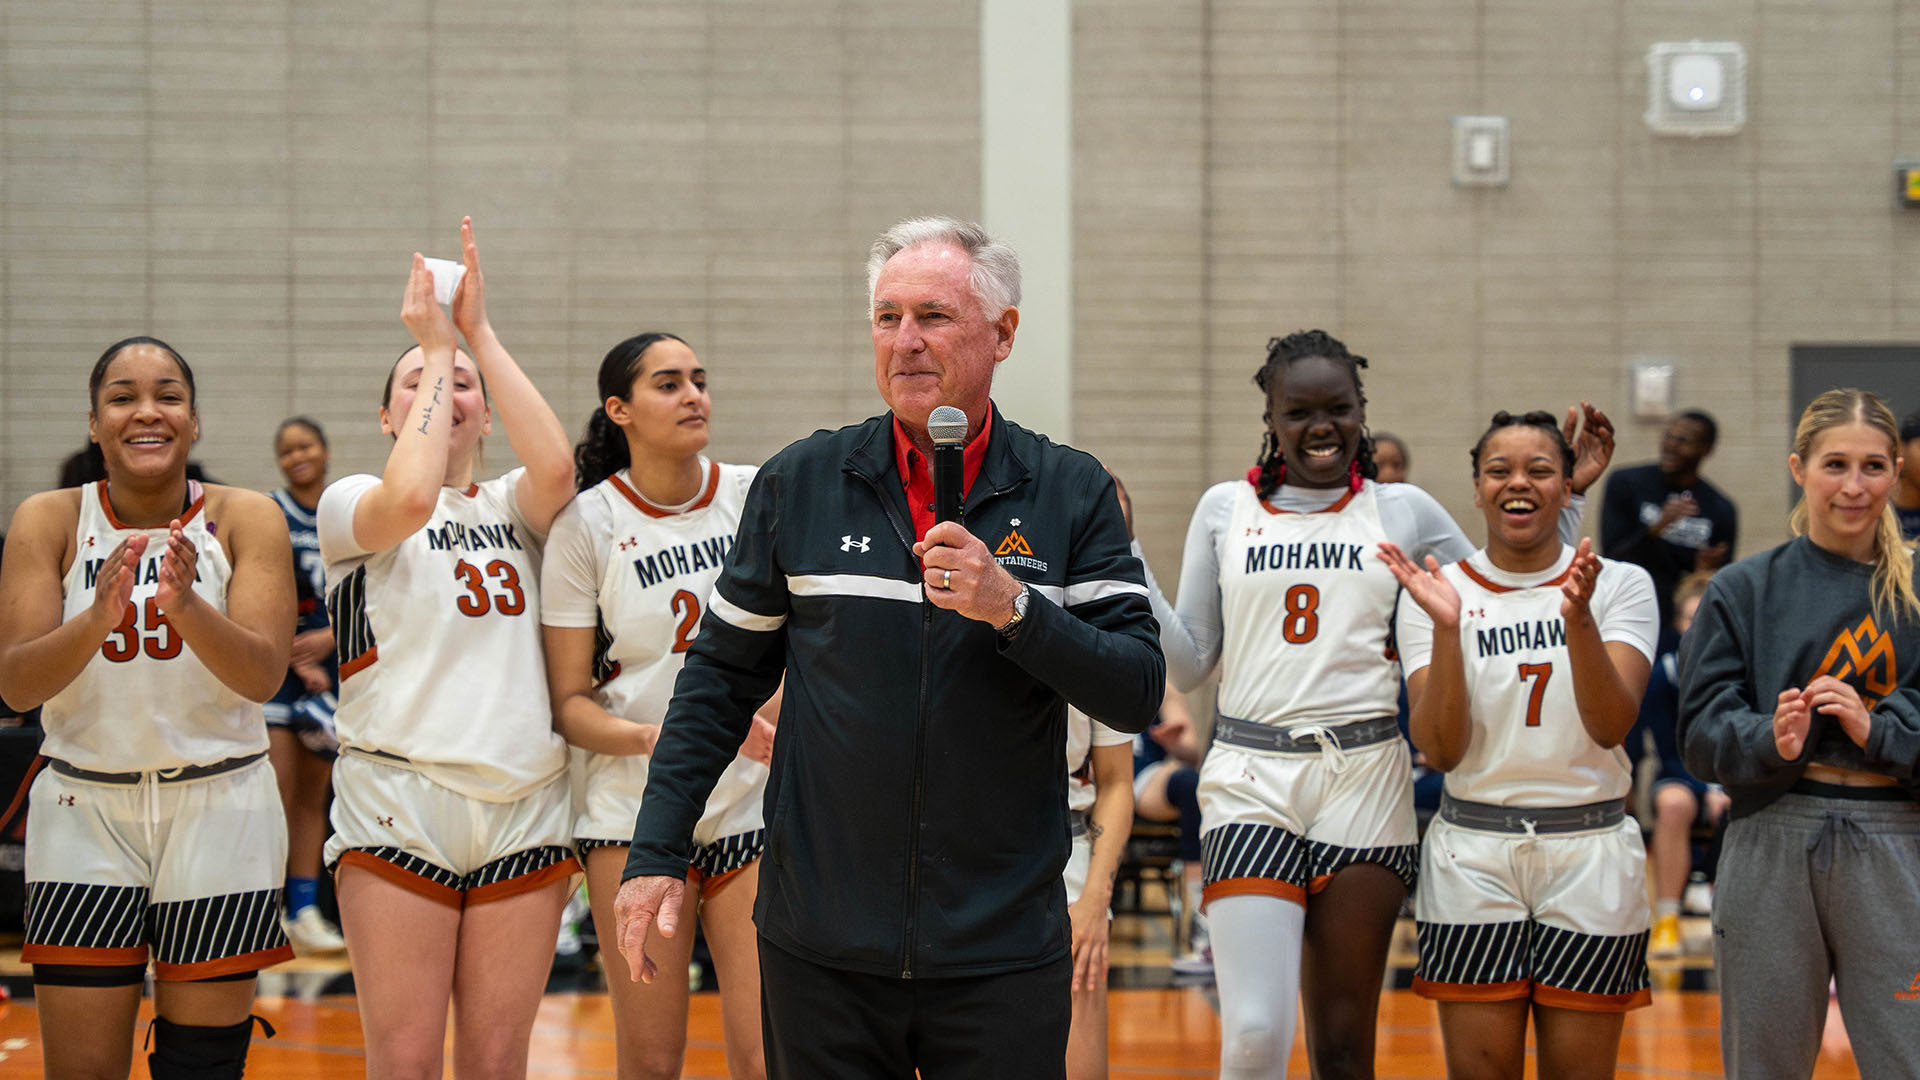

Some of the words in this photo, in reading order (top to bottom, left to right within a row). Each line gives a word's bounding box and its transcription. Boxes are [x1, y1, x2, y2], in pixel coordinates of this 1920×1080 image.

[427, 520, 522, 552] MOHAWK
[633, 535, 737, 589] MOHAW
[1245, 542, 1364, 574] MOHAWK
[454, 558, 526, 617] 33
[994, 556, 1048, 572] NTAINEERS
[102, 596, 183, 663] 35
[1282, 583, 1320, 644] 8
[1477, 618, 1567, 658] MOHAW
[1518, 661, 1553, 727] 7
